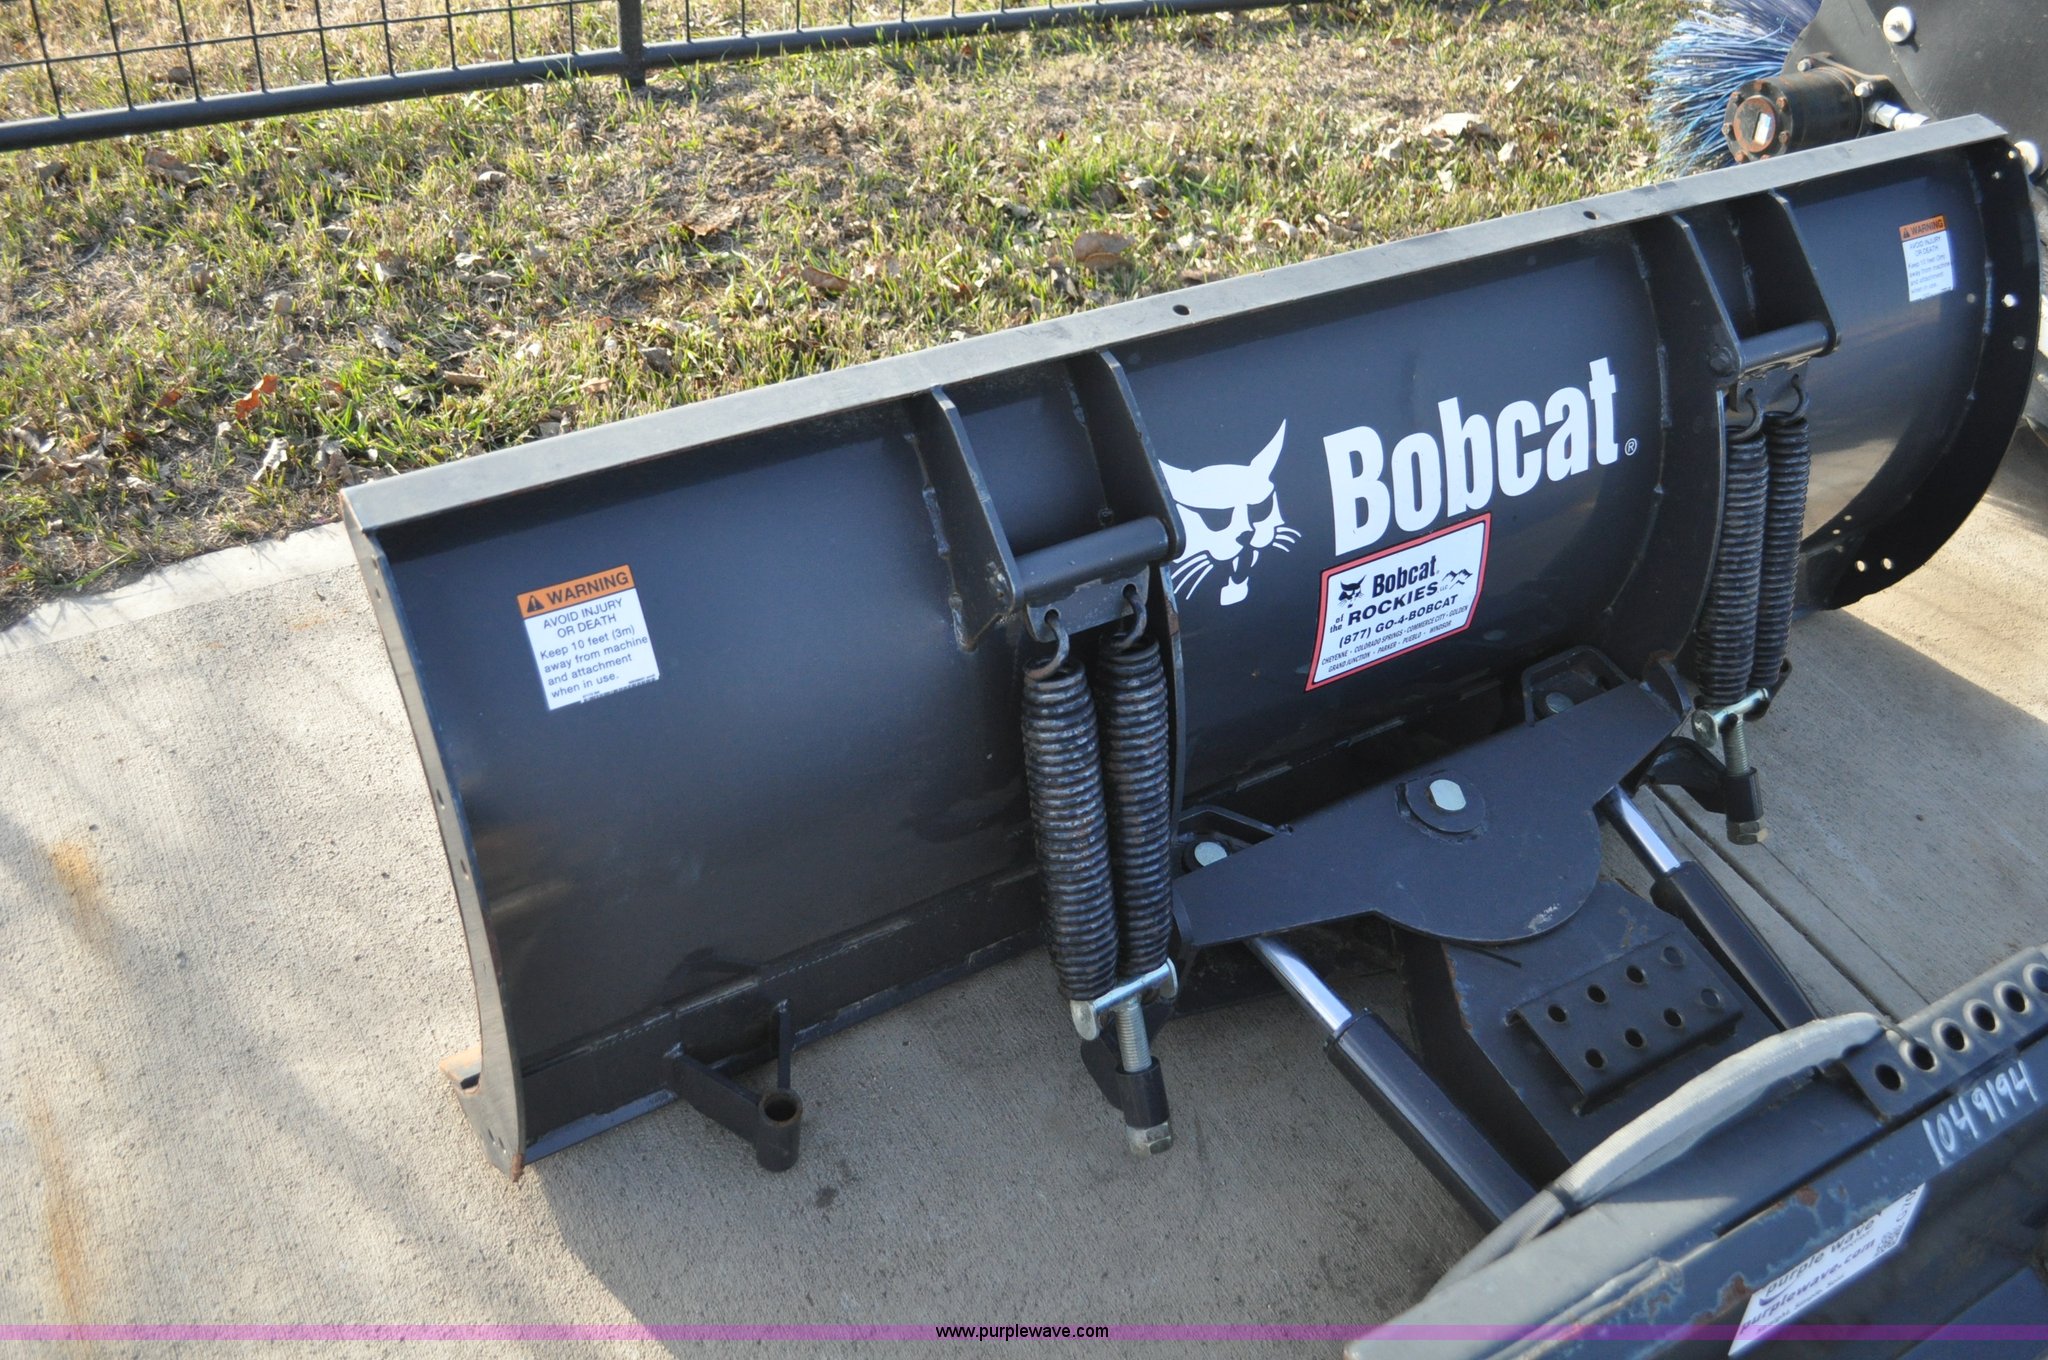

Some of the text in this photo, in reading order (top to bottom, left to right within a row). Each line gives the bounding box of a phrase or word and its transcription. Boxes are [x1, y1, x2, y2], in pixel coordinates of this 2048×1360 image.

[1910, 219, 1943, 235] WARNING
[1323, 357, 1619, 556] Bobcat
[546, 571, 629, 605] WARNING
[1371, 555, 1437, 598] Bobcat
[544, 598, 622, 629] AVOID INJURY
[1335, 613, 1344, 623] of
[1339, 594, 1459, 649] (877) GO-4-BOBCAT
[1347, 581, 1438, 626] ROCKIES
[540, 625, 635, 661] Keep 10 feet (3m)
[557, 613, 617, 638] OR DEATH
[1321, 650, 1349, 665] CHEYENNE
[1354, 638, 1382, 653] COLORADO
[1382, 629, 1403, 643] SPRINGS
[1434, 613, 1446, 622] CITY
[1329, 624, 1342, 633] the
[544, 636, 648, 673] away from machine
[548, 653, 633, 686] and attachment
[1328, 661, 1346, 672] GRAND
[1377, 641, 1397, 653] PARKER
[1402, 631, 1422, 644] PUEBLO
[551, 684, 580, 698] when
[583, 680, 593, 688] in
[596, 674, 620, 685] use.
[1739, 1238, 1876, 1334] purplewave.com
[1766, 1251, 1825, 1297] purple
